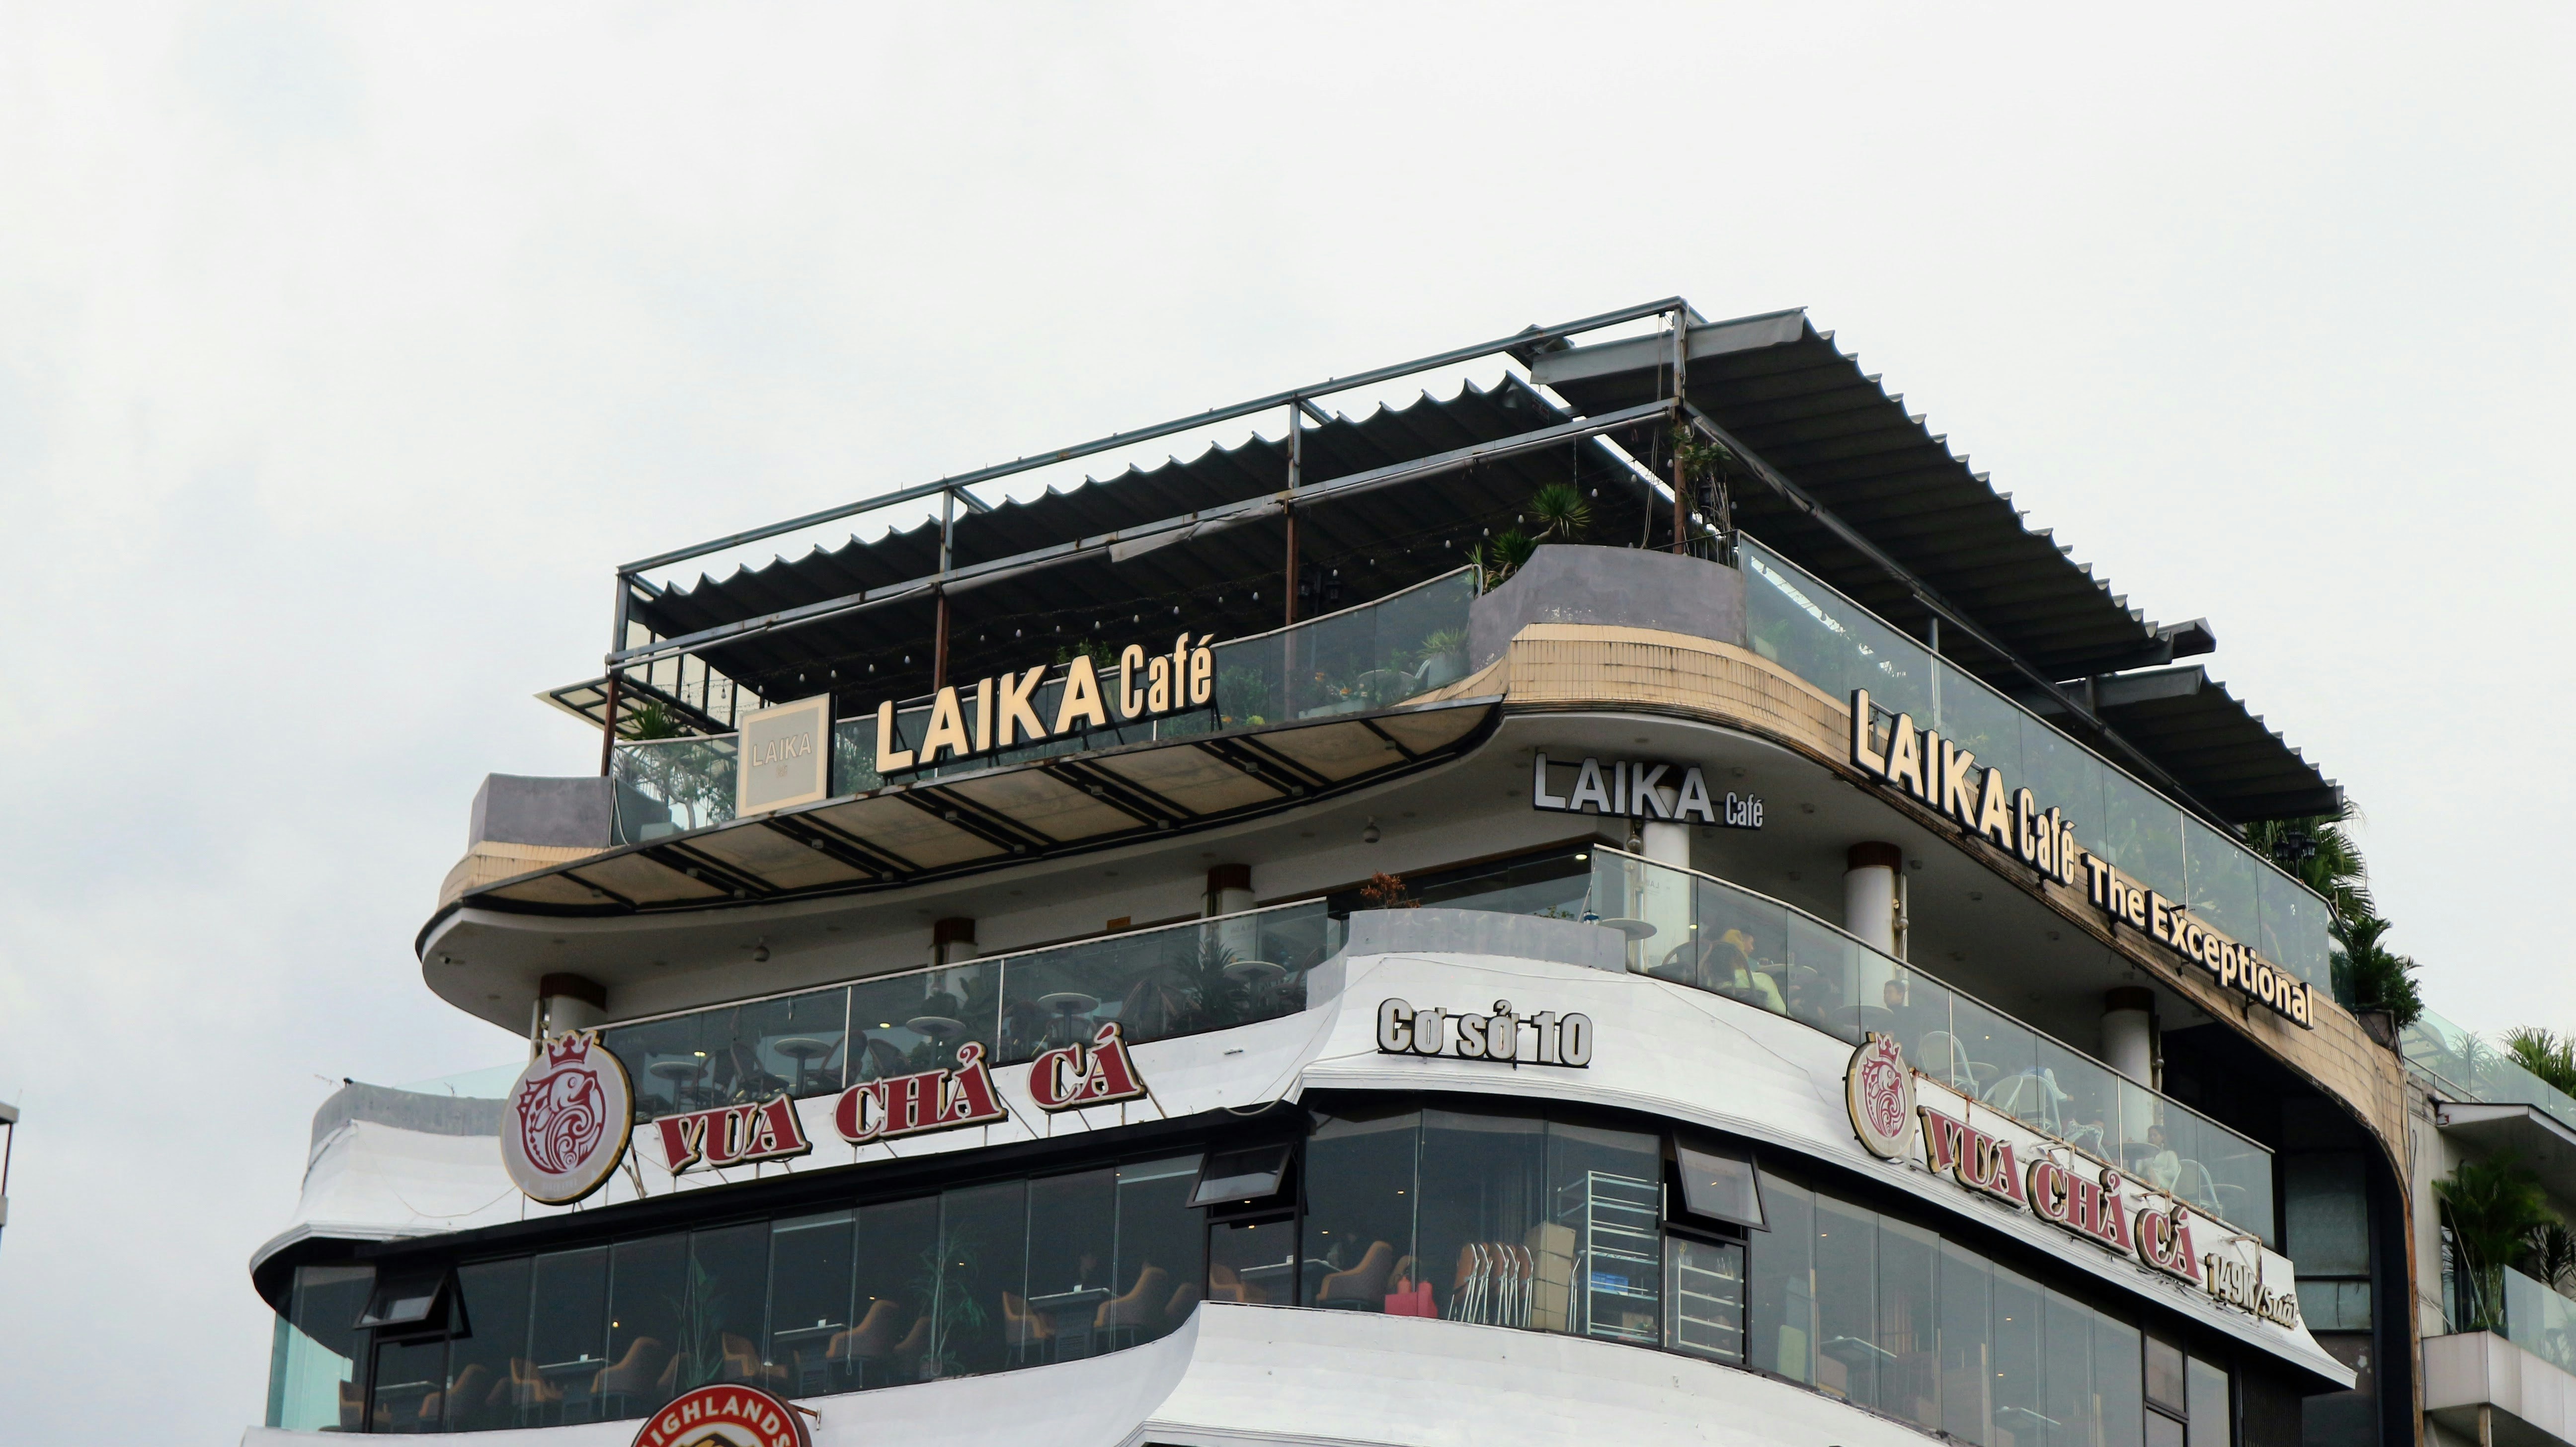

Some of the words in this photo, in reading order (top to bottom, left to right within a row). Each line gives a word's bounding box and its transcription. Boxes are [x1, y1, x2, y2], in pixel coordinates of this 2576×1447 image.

[752, 732, 812, 767] LAIKA
[875, 653, 1109, 774] LAIKA
[1119, 631, 1216, 720] Café
[1533, 752, 1715, 823] LAIKA
[1724, 791, 1764, 828] Café
[1851, 688, 2012, 853] LAIKA
[2013, 787, 2077, 888] Café
[2081, 853, 2145, 928] The
[2145, 889, 2314, 1030] Exceptional
[1377, 997, 1447, 1055] Cơ
[1456, 999, 1520, 1059] sở
[1530, 1010, 1593, 1066] 10
[651, 1093, 812, 1176] VUA
[832, 1041, 1009, 1145] CHẢ
[1027, 1021, 1148, 1114] CÁ
[1917, 1105, 2027, 1208] VUA
[2026, 1159, 2135, 1256] CHẢ
[2134, 1206, 2203, 1286] CÁ
[642, 1394, 792, 1447] IGHLANDS
